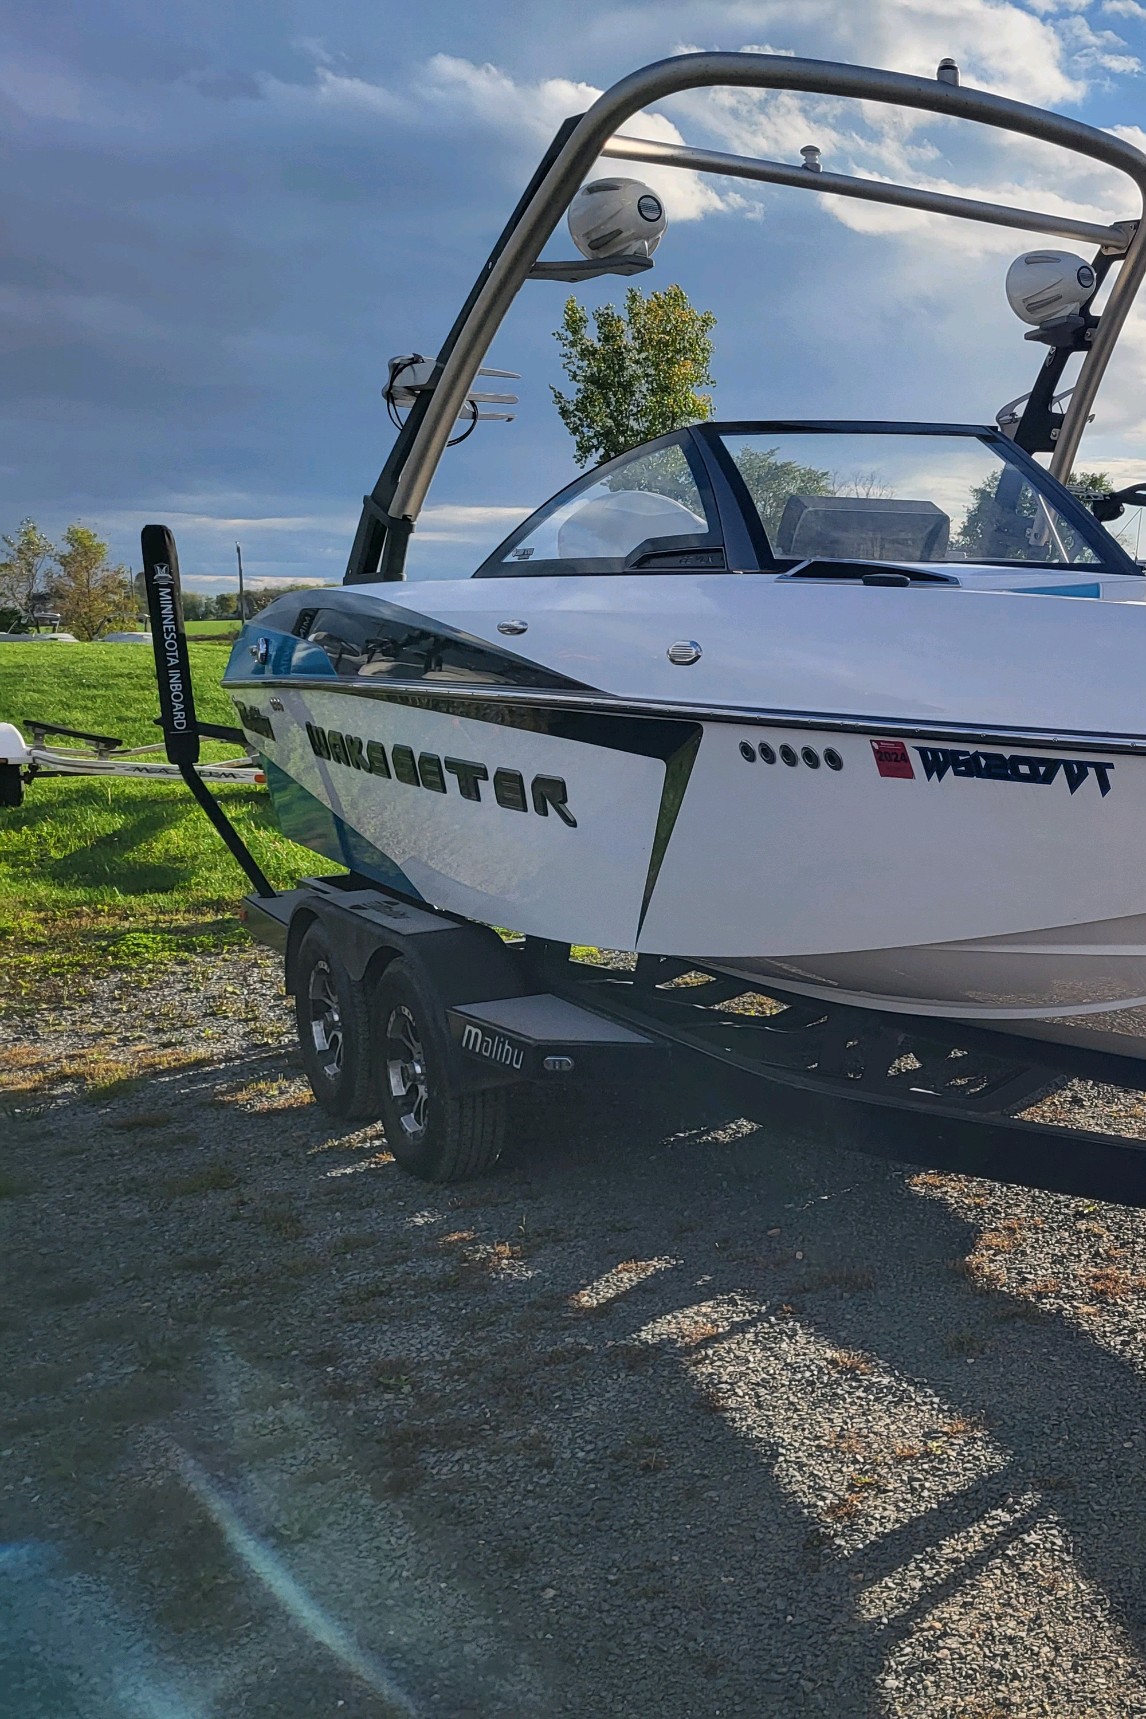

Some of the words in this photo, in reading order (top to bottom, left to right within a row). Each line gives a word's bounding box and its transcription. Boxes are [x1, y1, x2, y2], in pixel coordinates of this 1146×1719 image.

[159, 588, 180, 667] MINNESOTA
[168, 670, 187, 730] INBOARD
[876, 750, 909, 763] 2024
